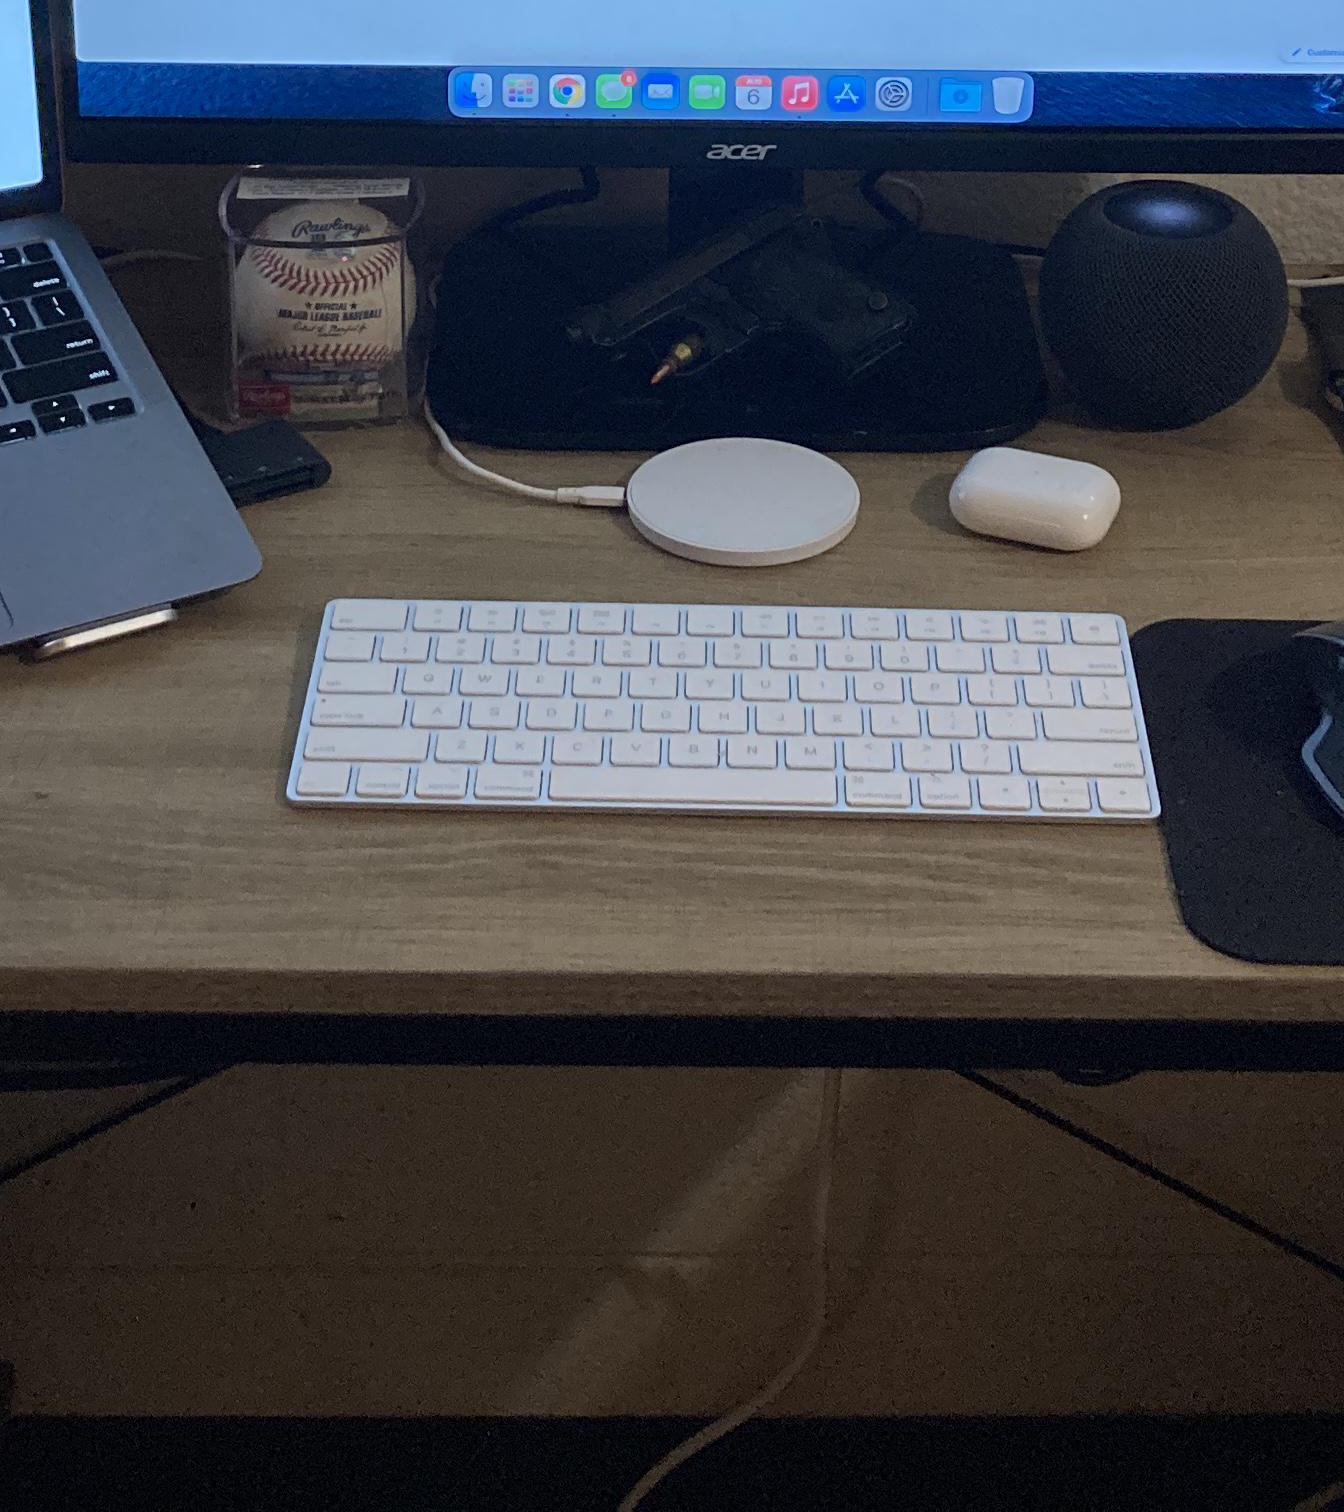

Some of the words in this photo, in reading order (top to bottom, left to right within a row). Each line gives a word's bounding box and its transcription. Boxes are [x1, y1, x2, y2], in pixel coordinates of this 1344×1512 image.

[747, 89, 760, 106] 6
[706, 143, 778, 161] acer
[291, 217, 372, 239] Rawlings
[310, 310, 341, 322] LEAGUE
[89, 368, 111, 380] shift
